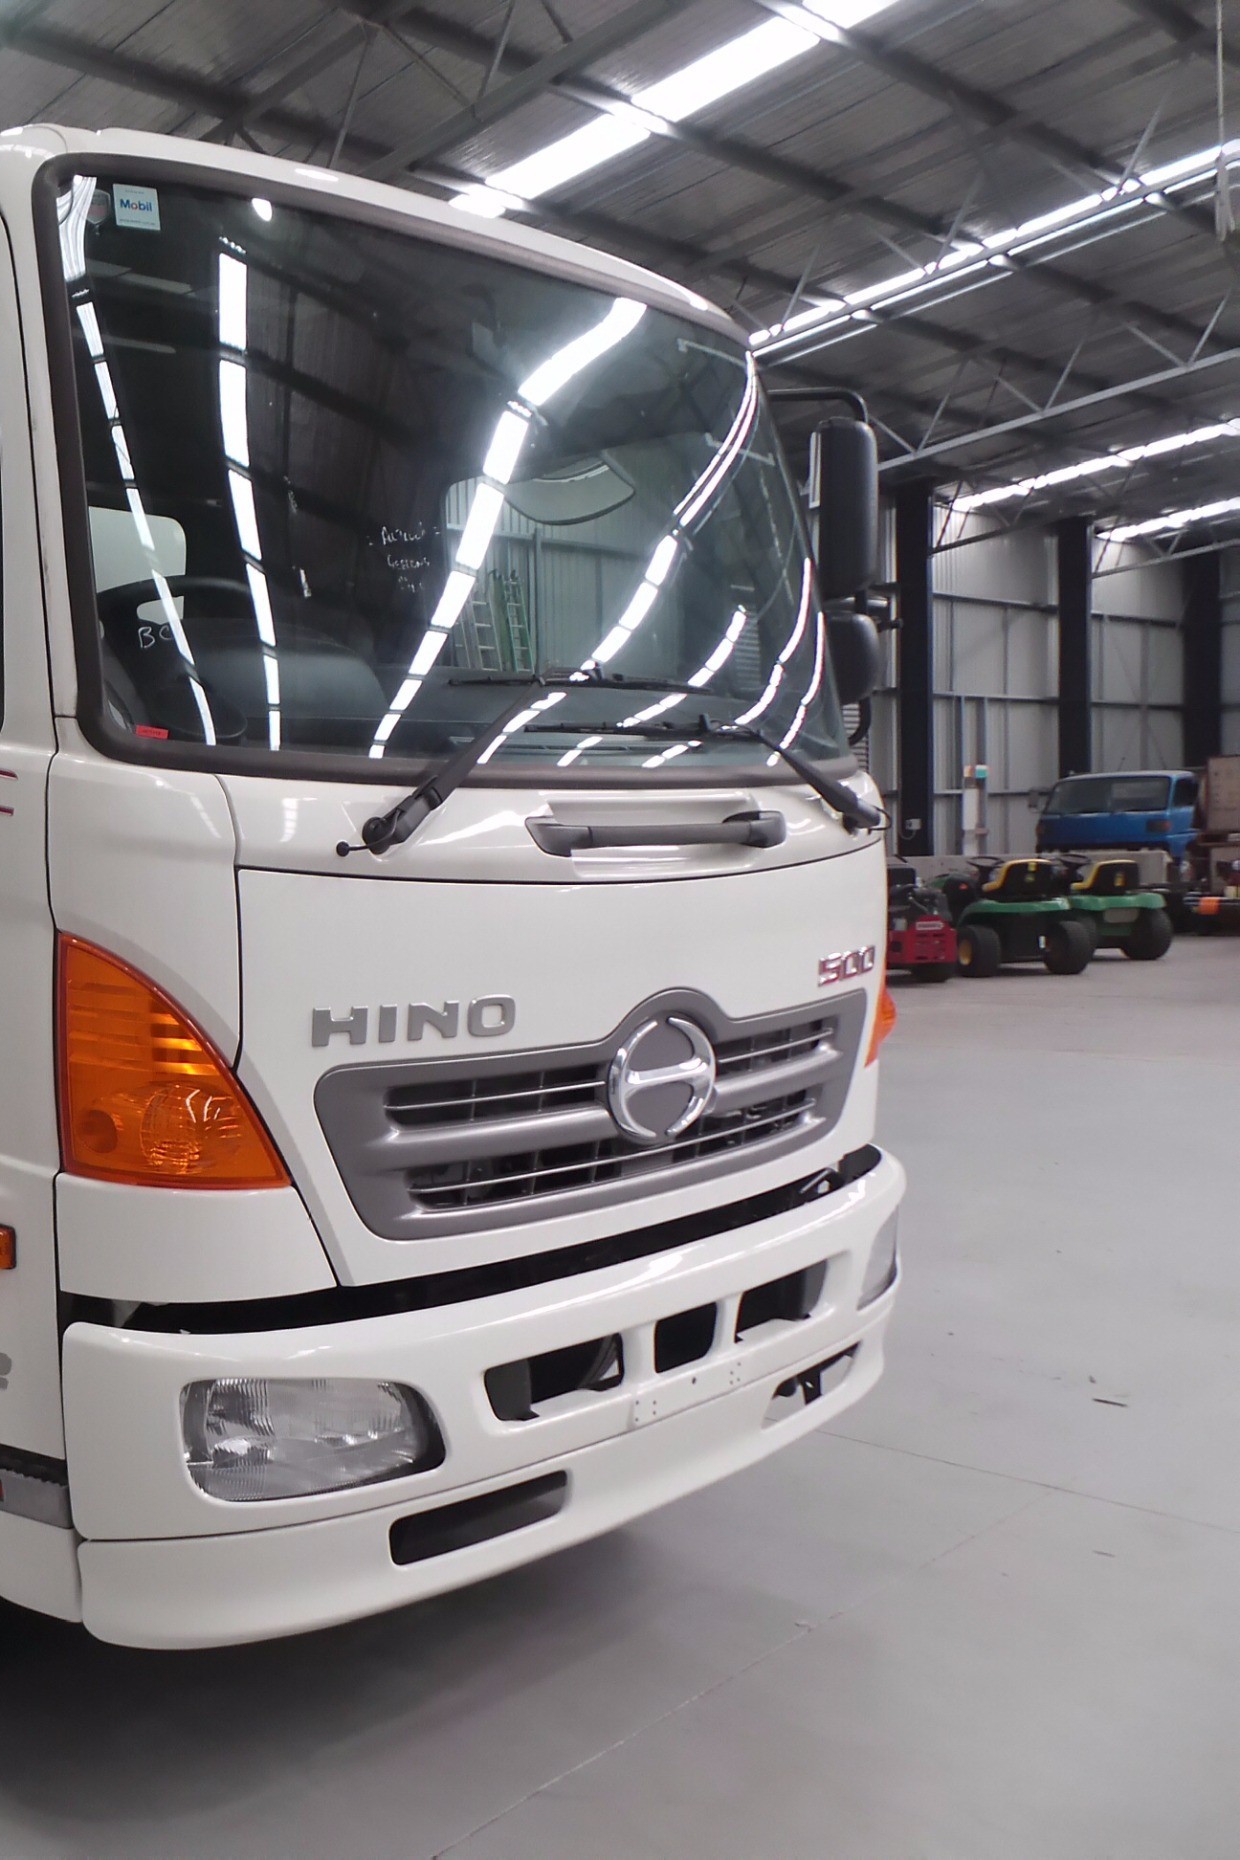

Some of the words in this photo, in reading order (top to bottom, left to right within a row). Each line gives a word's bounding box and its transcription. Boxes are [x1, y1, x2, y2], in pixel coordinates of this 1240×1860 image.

[120, 198, 153, 212] Mobil
[818, 945, 875, 987] 500
[312, 993, 516, 1047] HINO
